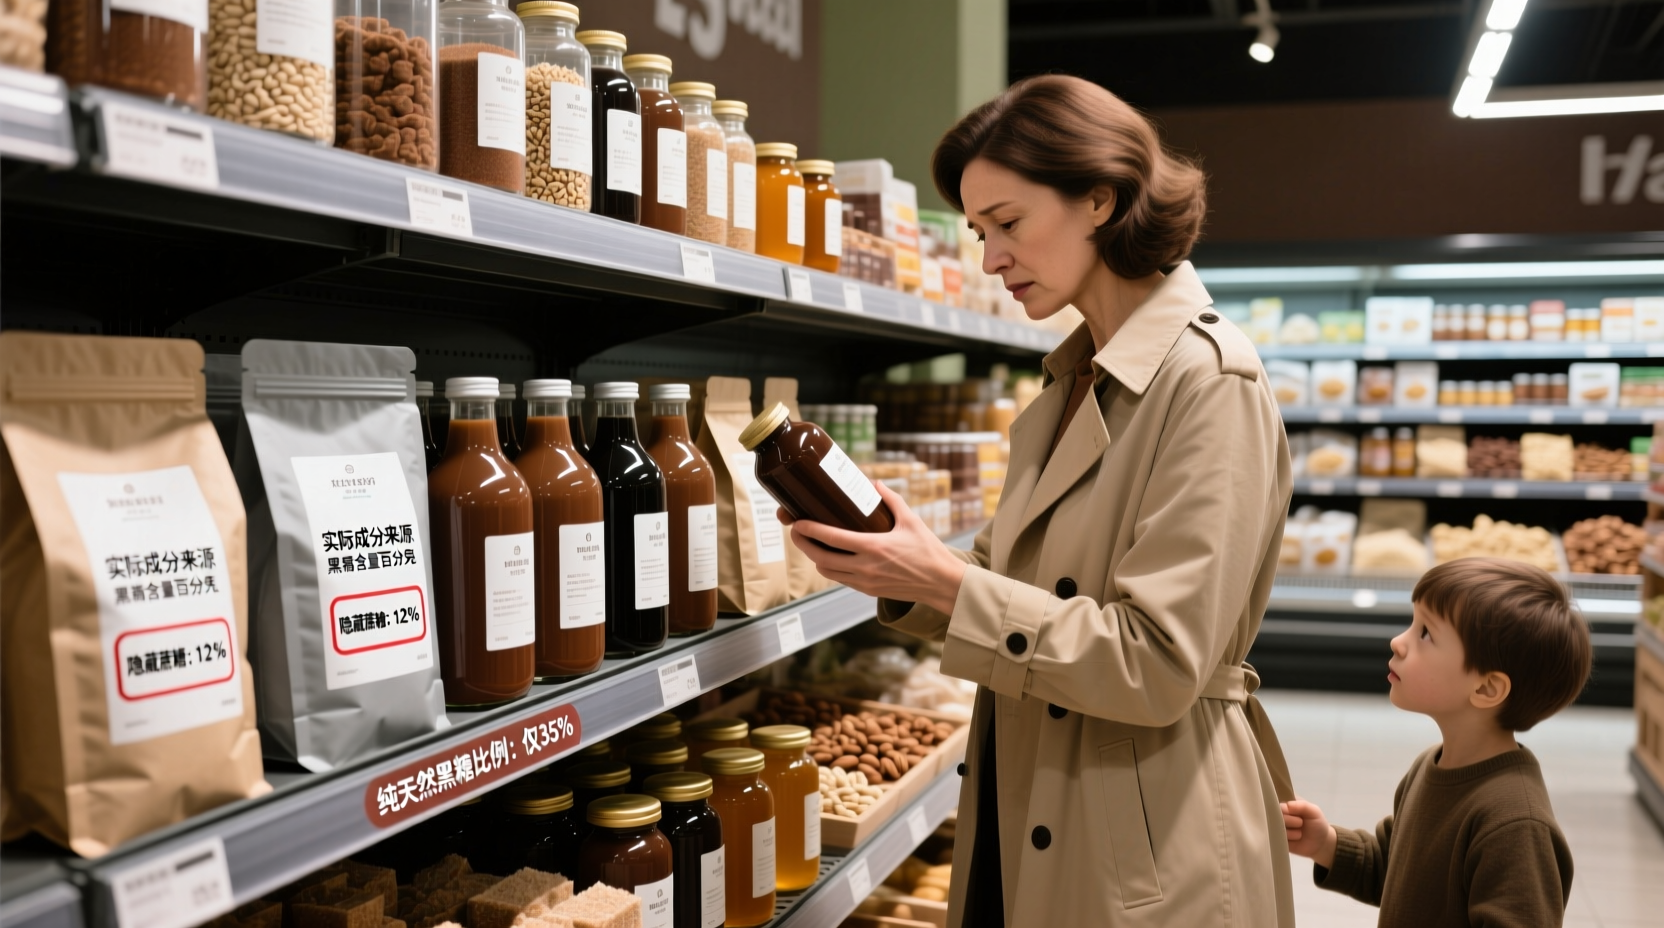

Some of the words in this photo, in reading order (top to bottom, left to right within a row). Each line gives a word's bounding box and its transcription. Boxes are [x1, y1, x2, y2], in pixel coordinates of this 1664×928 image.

[322, 524, 414, 552] 实际成分来源
[105, 547, 216, 579] 实际成分来源
[393, 606, 420, 624] 12%
[196, 641, 227, 663] 12%
